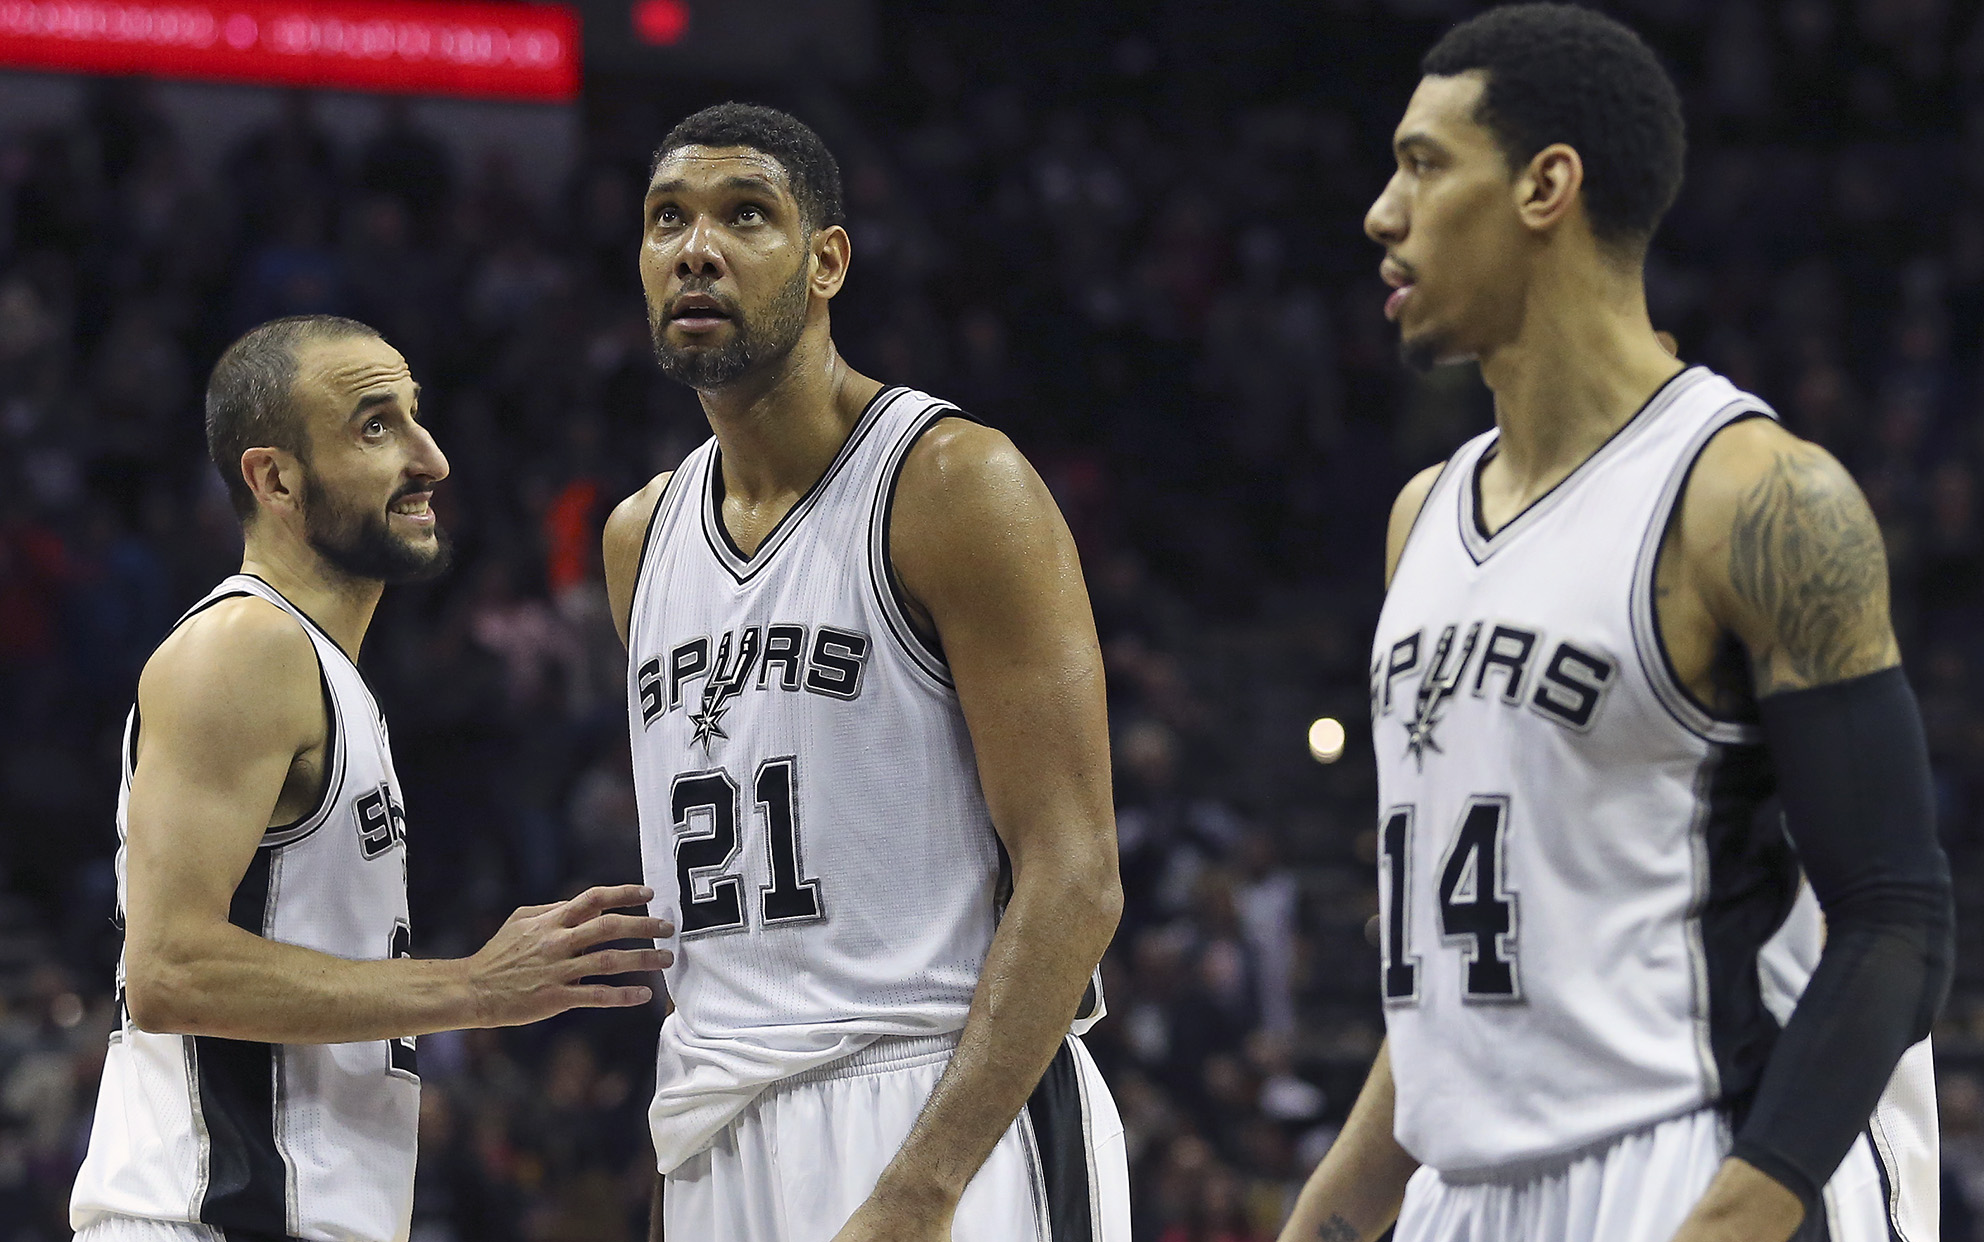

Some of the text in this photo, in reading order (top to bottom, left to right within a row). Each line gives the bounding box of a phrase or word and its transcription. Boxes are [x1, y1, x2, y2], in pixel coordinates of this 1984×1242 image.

[637, 623, 872, 740] SPURS
[670, 754, 827, 942] 21
[1379, 794, 1527, 1007] 14
